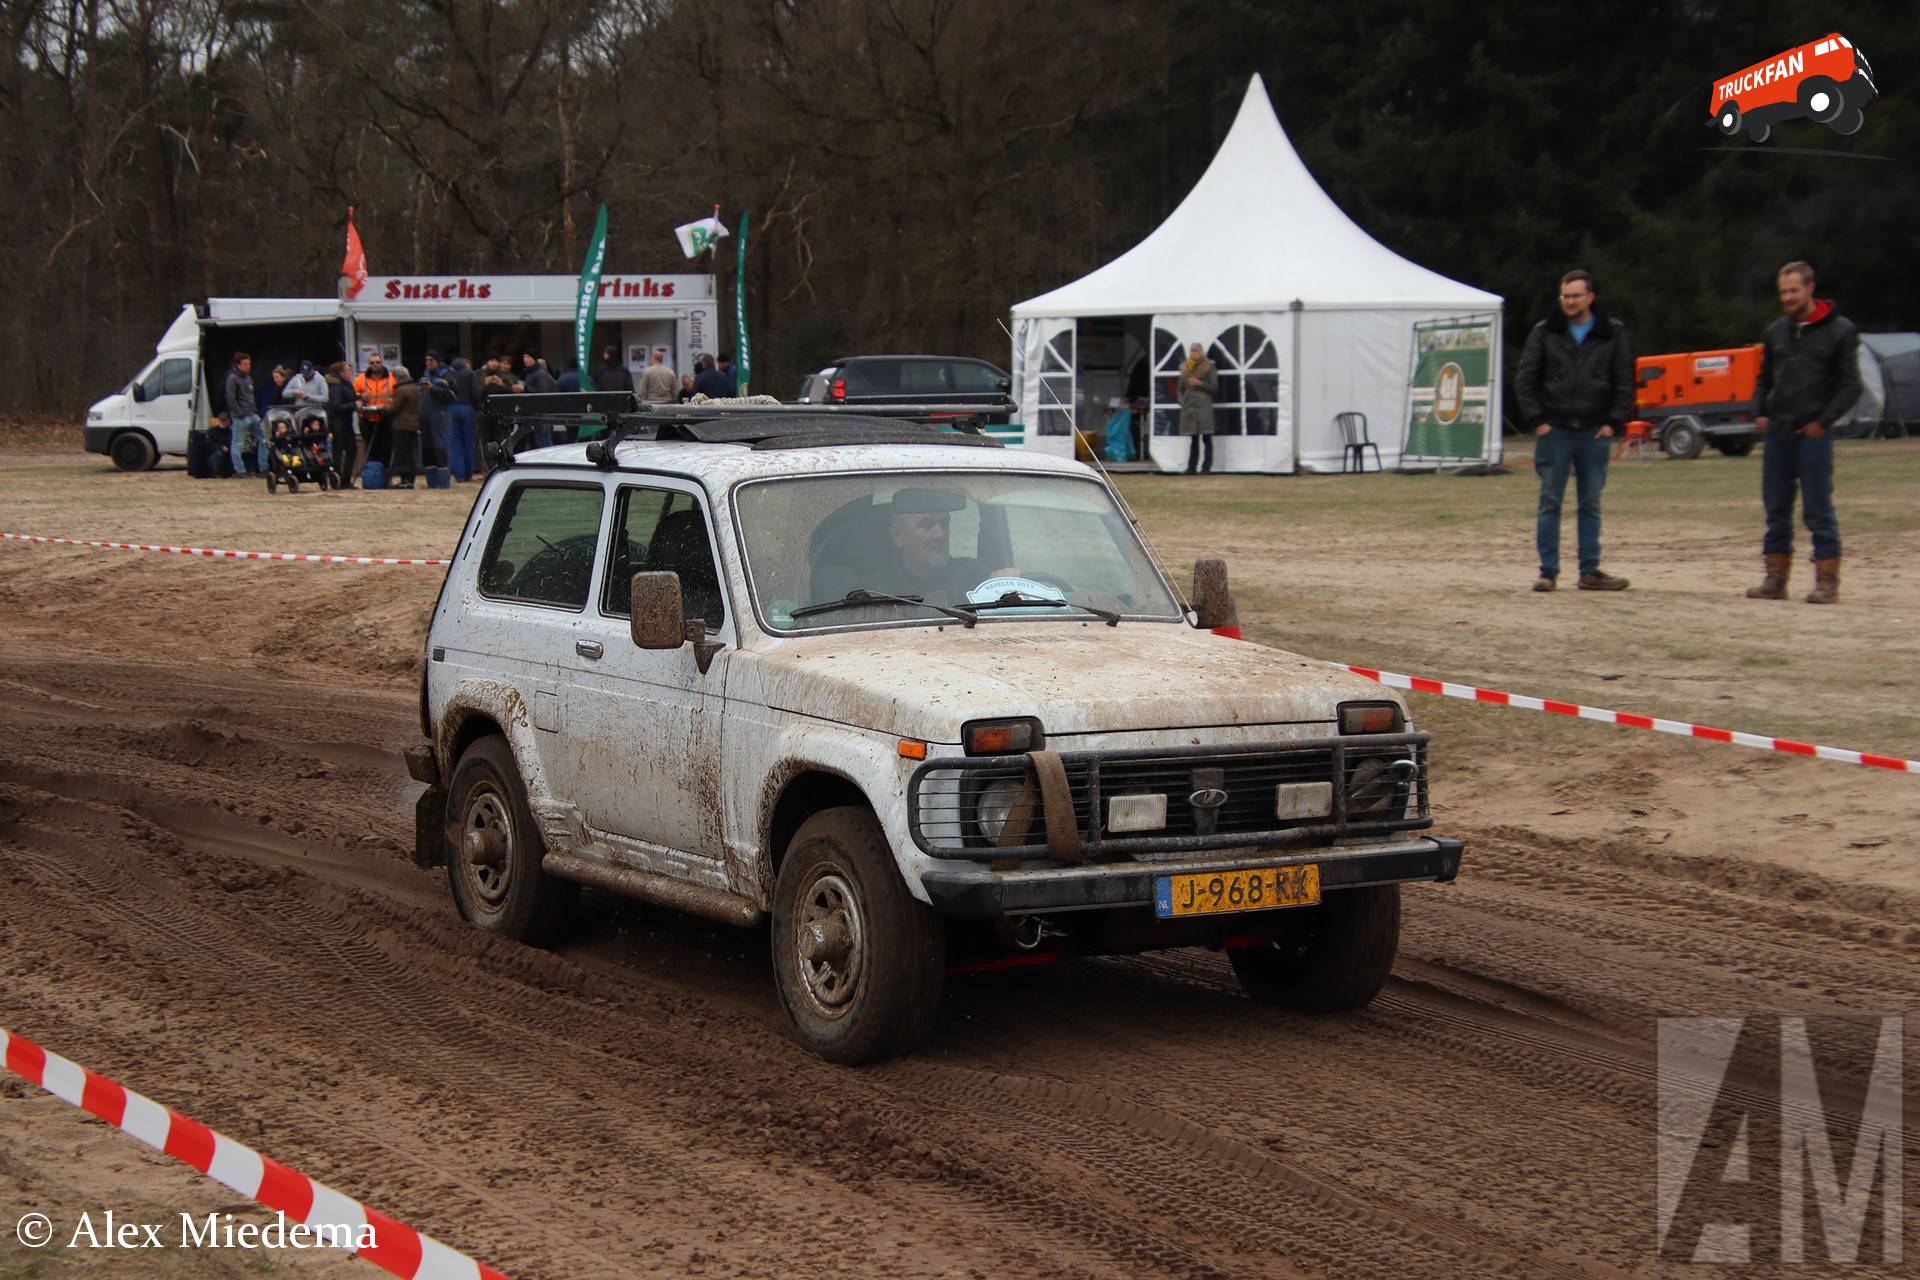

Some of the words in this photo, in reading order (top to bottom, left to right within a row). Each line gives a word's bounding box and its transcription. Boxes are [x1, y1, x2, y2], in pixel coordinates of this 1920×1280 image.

[384, 278, 492, 299] Snacks
[577, 277, 675, 298] rinks
[688, 310, 706, 349] Catering
[1158, 899, 1170, 909] NL
